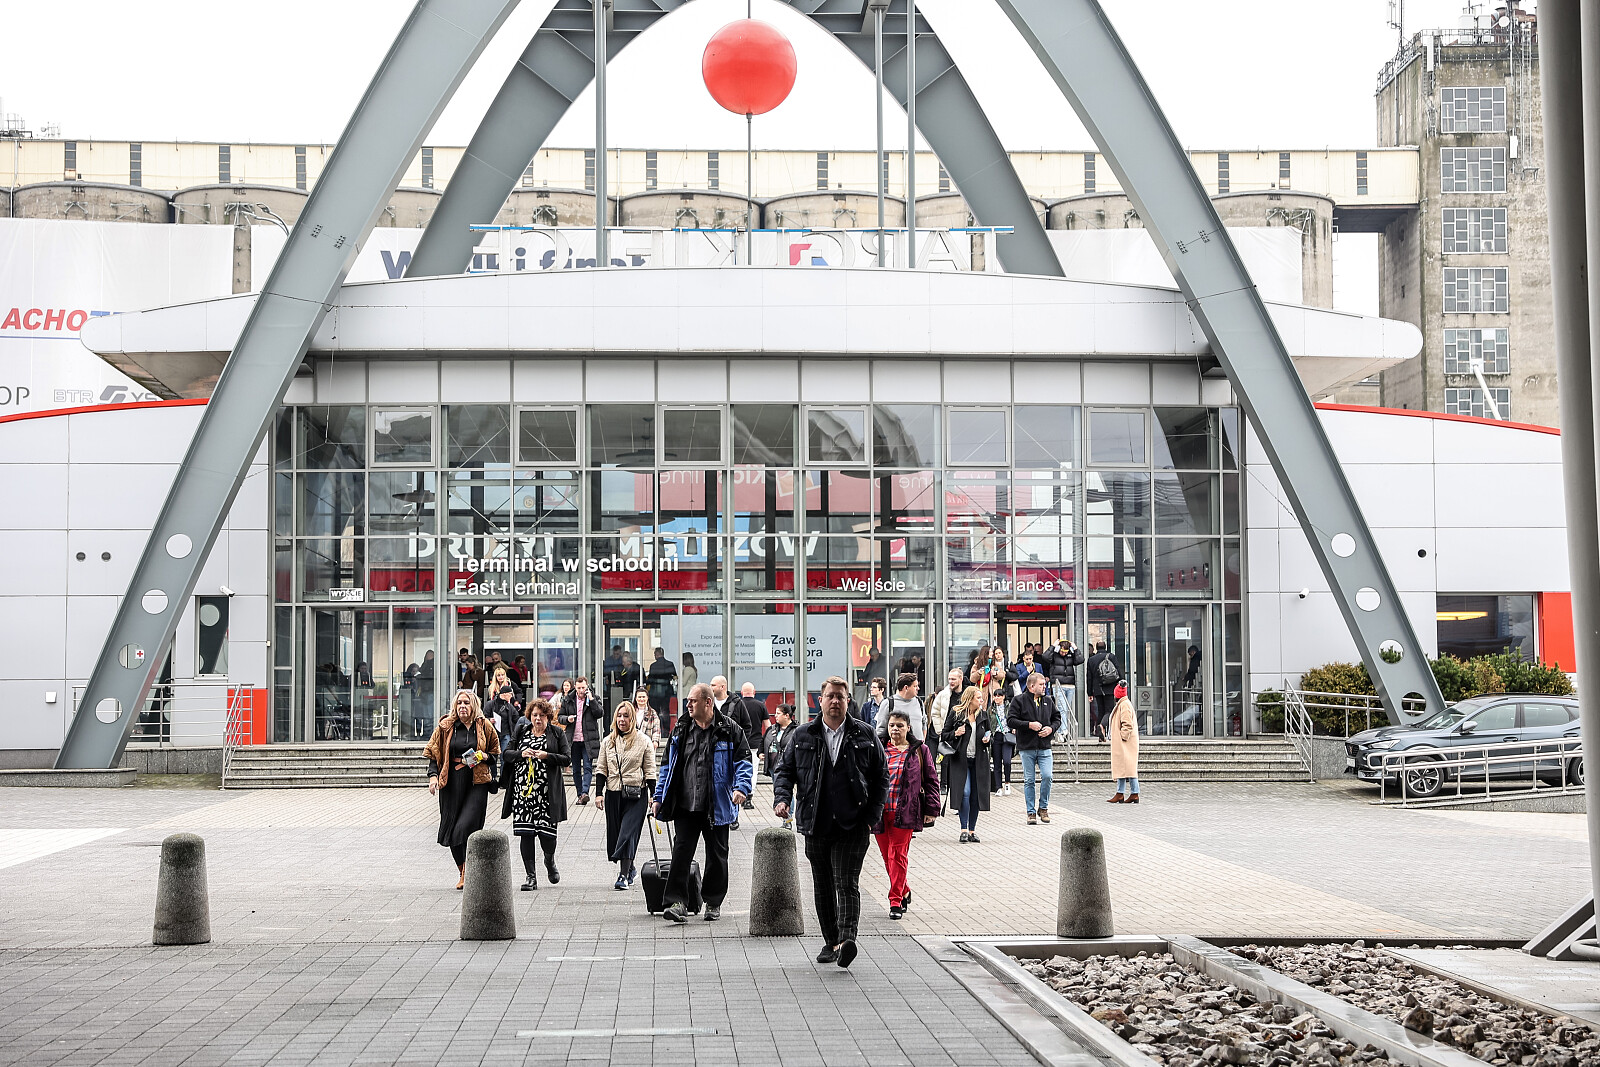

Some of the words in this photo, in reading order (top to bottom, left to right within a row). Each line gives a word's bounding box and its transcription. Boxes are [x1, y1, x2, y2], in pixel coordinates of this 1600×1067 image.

[53, 389, 94, 403] BTR
[455, 553, 553, 572] Terminal
[981, 578, 1054, 592] Entrance
